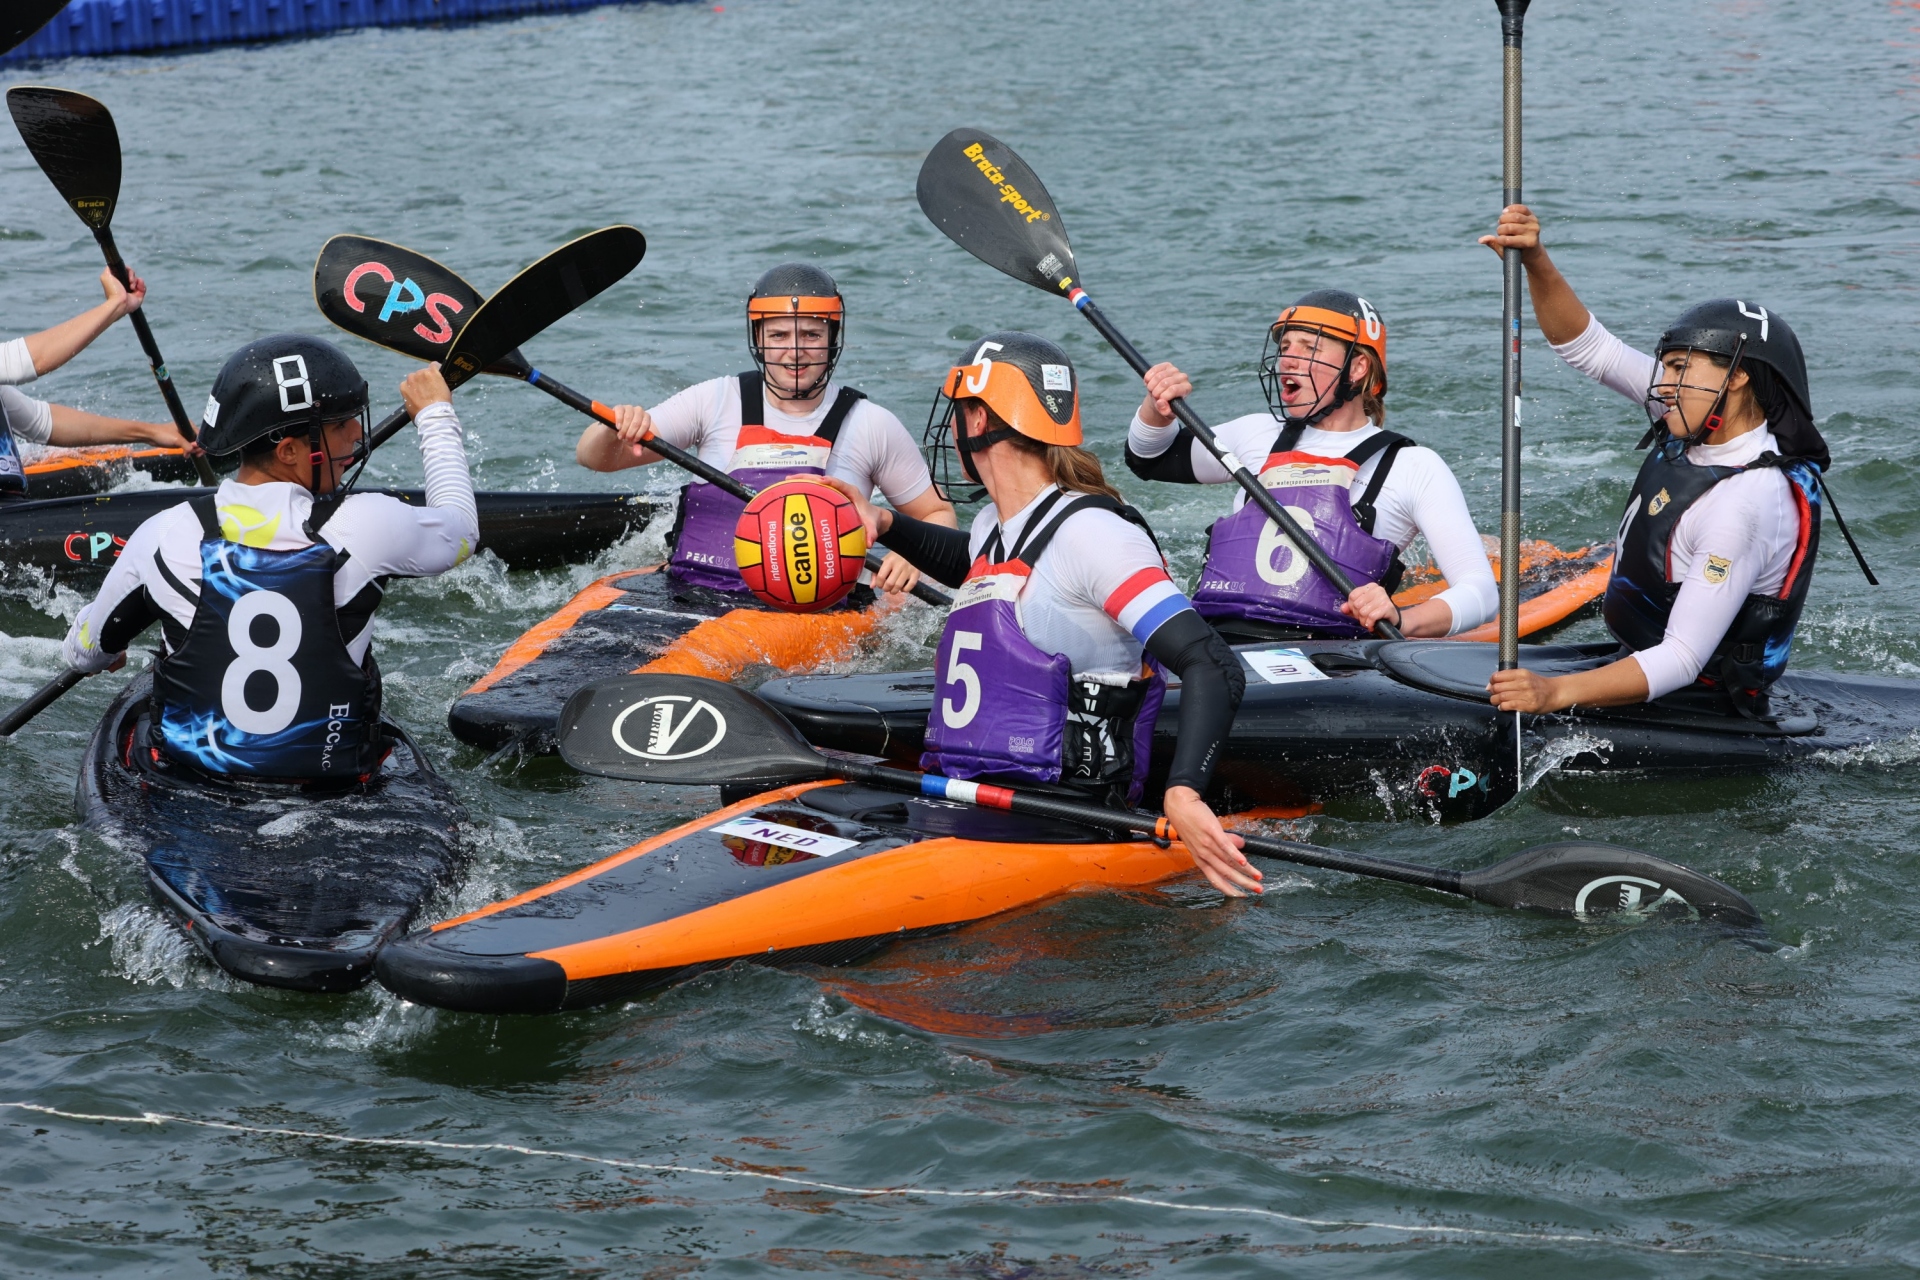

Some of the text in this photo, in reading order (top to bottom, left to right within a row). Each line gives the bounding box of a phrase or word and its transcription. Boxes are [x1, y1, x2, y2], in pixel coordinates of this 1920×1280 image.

[343, 261, 464, 344] CPS
[1358, 297, 1380, 340] 6
[1737, 300, 1768, 342] 4
[273, 354, 312, 412] 8
[966, 341, 1004, 394] 5
[686, 551, 714, 564] PEAK
[768, 520, 782, 581] international
[790, 512, 813, 585] canoe
[820, 519, 835, 579] federation
[1255, 505, 1315, 586] 6
[1204, 580, 1231, 592] PEAK
[221, 590, 302, 735] 8
[942, 630, 982, 729] 5
[1267, 664, 1302, 676] IRI
[648, 707, 664, 749] VORTEX
[1009, 736, 1034, 746] POLO
[1419, 765, 1482, 799] CP
[752, 828, 819, 847] NED
